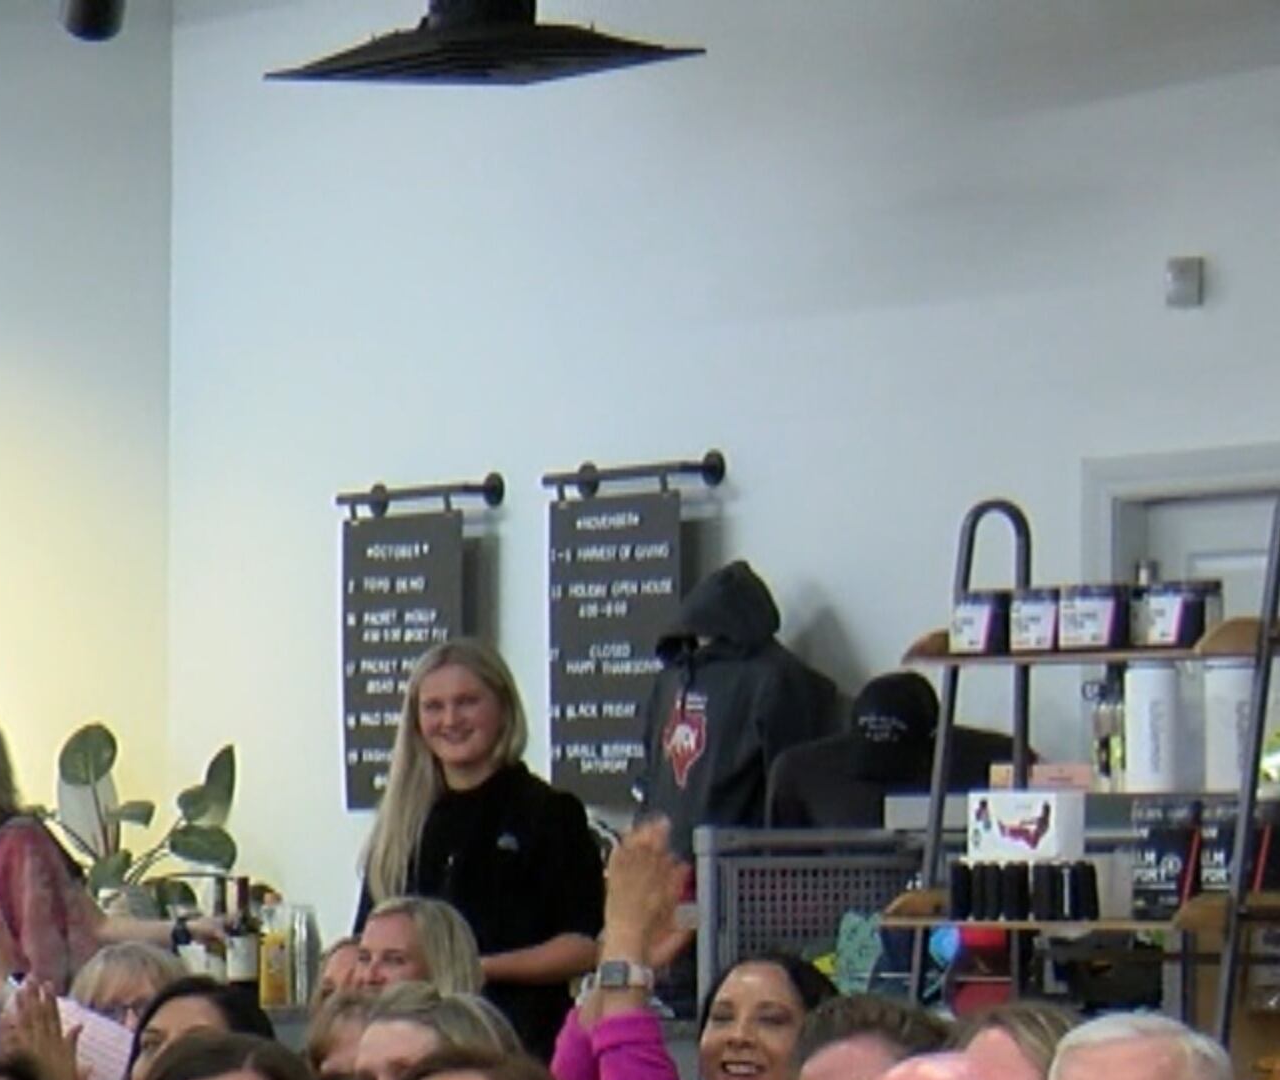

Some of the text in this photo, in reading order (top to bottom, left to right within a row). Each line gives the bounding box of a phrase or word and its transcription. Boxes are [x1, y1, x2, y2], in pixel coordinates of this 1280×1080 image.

[619, 543, 631, 561] OF
[568, 582, 608, 598] HOLIDAY
[610, 579, 639, 597] OPEN
[641, 577, 672, 595] HOUSE
[589, 643, 631, 659] CLOSED
[360, 658, 397, 673] PACKET
[566, 660, 595, 674] HAPPY
[566, 703, 597, 720] BLACK
[602, 702, 636, 718] FRIDAY
[565, 743, 597, 758] SMALL
[580, 759, 628, 773] SATURDAY
